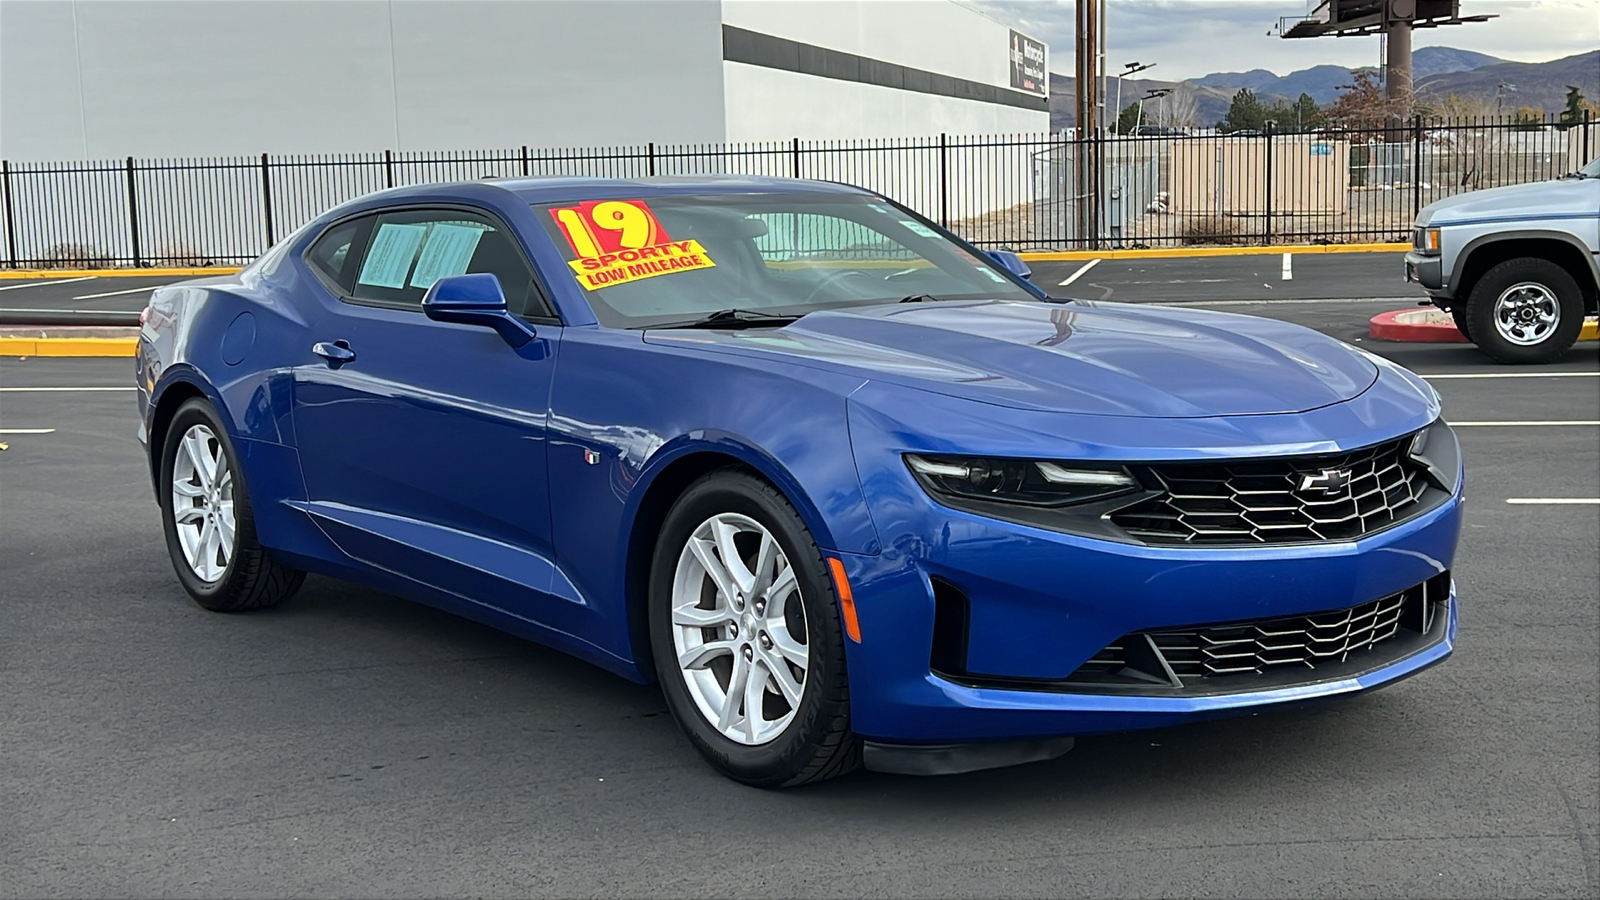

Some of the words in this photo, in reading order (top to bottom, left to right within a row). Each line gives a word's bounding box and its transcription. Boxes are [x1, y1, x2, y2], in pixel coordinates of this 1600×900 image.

[557, 201, 655, 257] 19
[581, 241, 693, 271] SPORTY
[586, 268, 627, 286] LOW
[629, 254, 704, 277] MILEAGE
